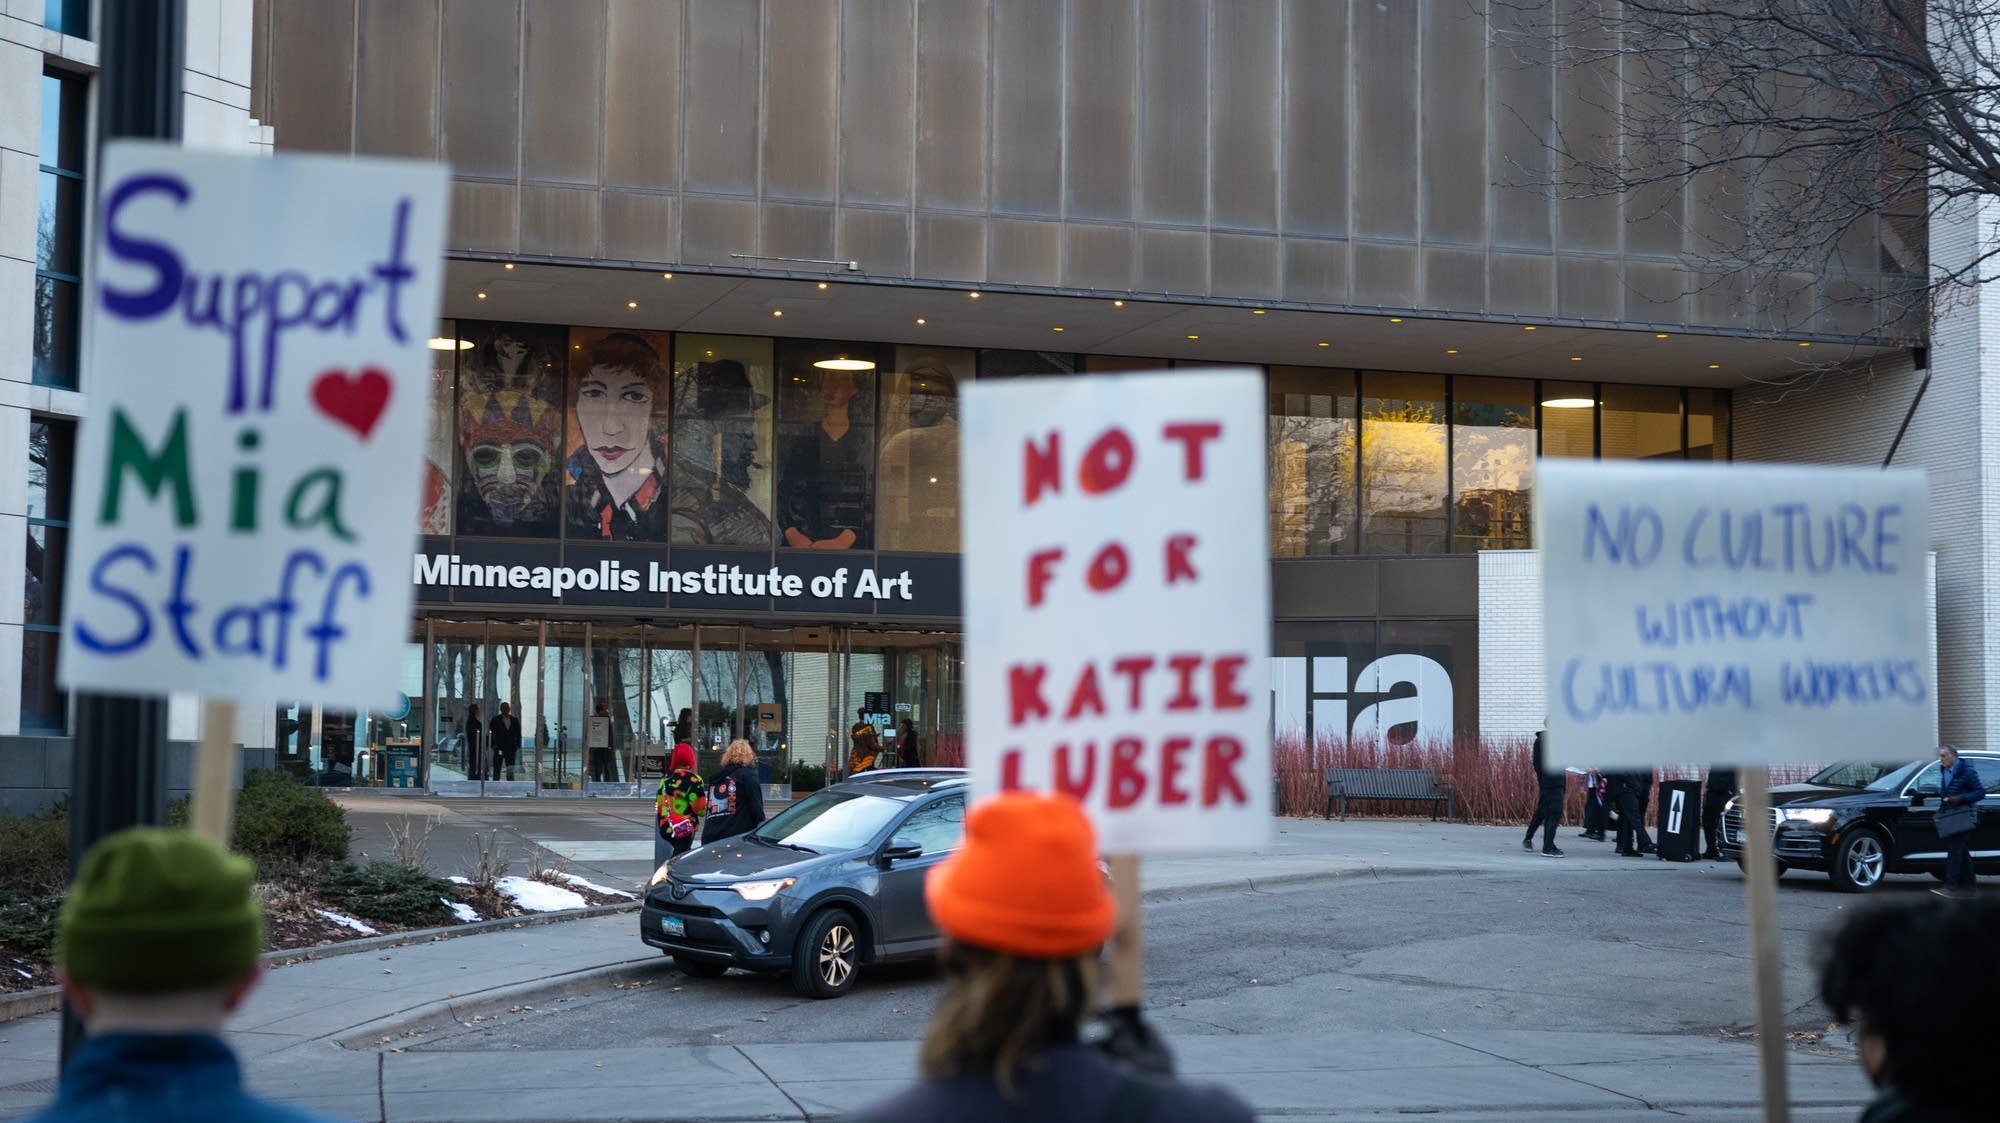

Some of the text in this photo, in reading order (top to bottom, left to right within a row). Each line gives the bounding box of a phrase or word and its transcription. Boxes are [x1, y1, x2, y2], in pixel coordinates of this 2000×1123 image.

[101, 173, 416, 414] Support
[97, 402, 361, 543] Mia
[1022, 420, 1222, 507] NOT
[412, 554, 913, 600] Minneapolis Institute of Art
[1025, 533, 1199, 608] FOR
[1583, 502, 1901, 577] NO CULTURE
[72, 541, 373, 683] Staff
[1634, 593, 1815, 649] WITHOUT
[863, 713, 892, 725] Mia
[1007, 654, 1250, 727] KATIE
[1270, 653, 1454, 768] ia
[1000, 735, 1248, 809] LUBER
